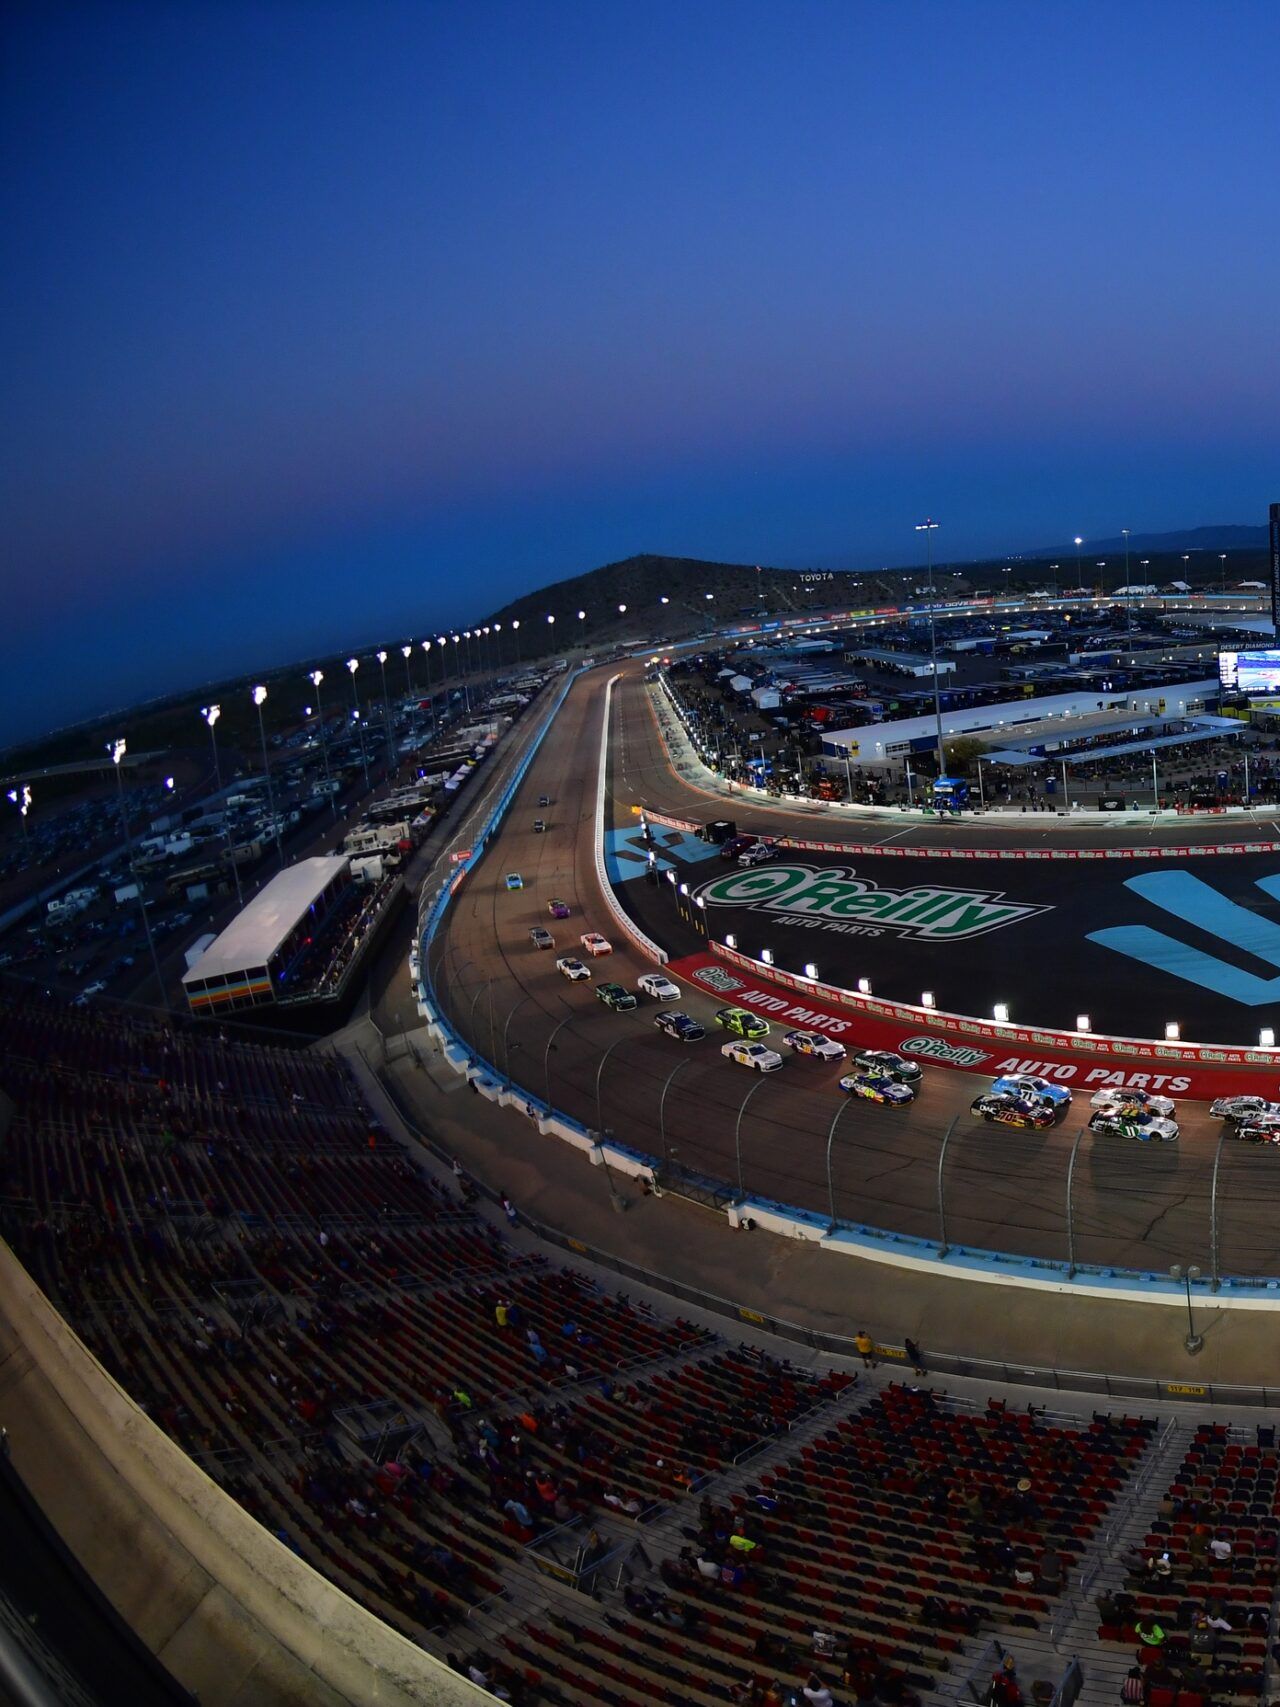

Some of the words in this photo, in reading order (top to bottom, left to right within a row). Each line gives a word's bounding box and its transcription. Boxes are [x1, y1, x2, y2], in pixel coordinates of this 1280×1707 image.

[800, 572, 834, 582] TOYOTA
[706, 867, 1016, 934] O'Reilly
[772, 916, 822, 929] AUTO
[822, 920, 886, 938] PARTS
[737, 990, 789, 1011] AUTO
[782, 1006, 853, 1033] PARTS
[1154, 1046, 1182, 1059] O'Reilly
[1200, 1050, 1227, 1061] O'Reilly
[1244, 1052, 1273, 1064] O'Reilly
[901, 1038, 984, 1066] O'Reilly
[995, 1057, 1078, 1079] AUTO
[1084, 1068, 1192, 1092] PARTS
[1022, 1090, 1032, 1100] 71
[1125, 1126, 1136, 1137] 11
